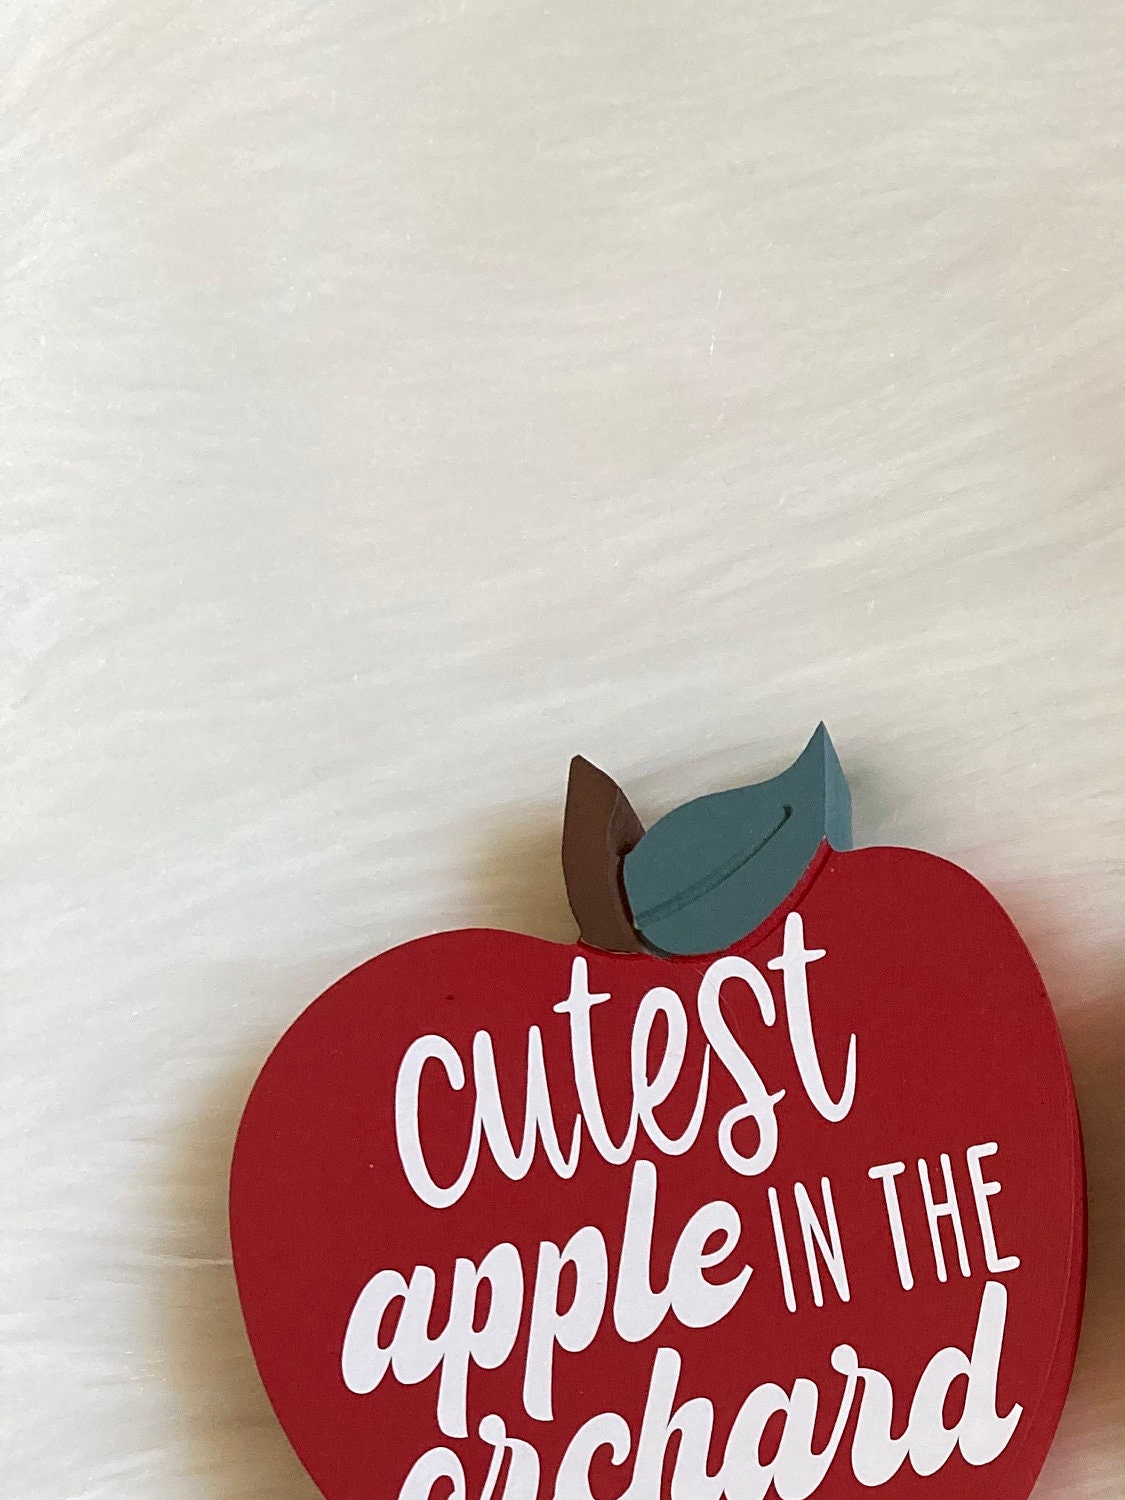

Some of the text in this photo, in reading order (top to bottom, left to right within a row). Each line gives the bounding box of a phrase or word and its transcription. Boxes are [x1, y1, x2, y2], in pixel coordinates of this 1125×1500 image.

[395, 912, 857, 1208] cutest
[342, 1142, 1020, 1438] apple IN THE
